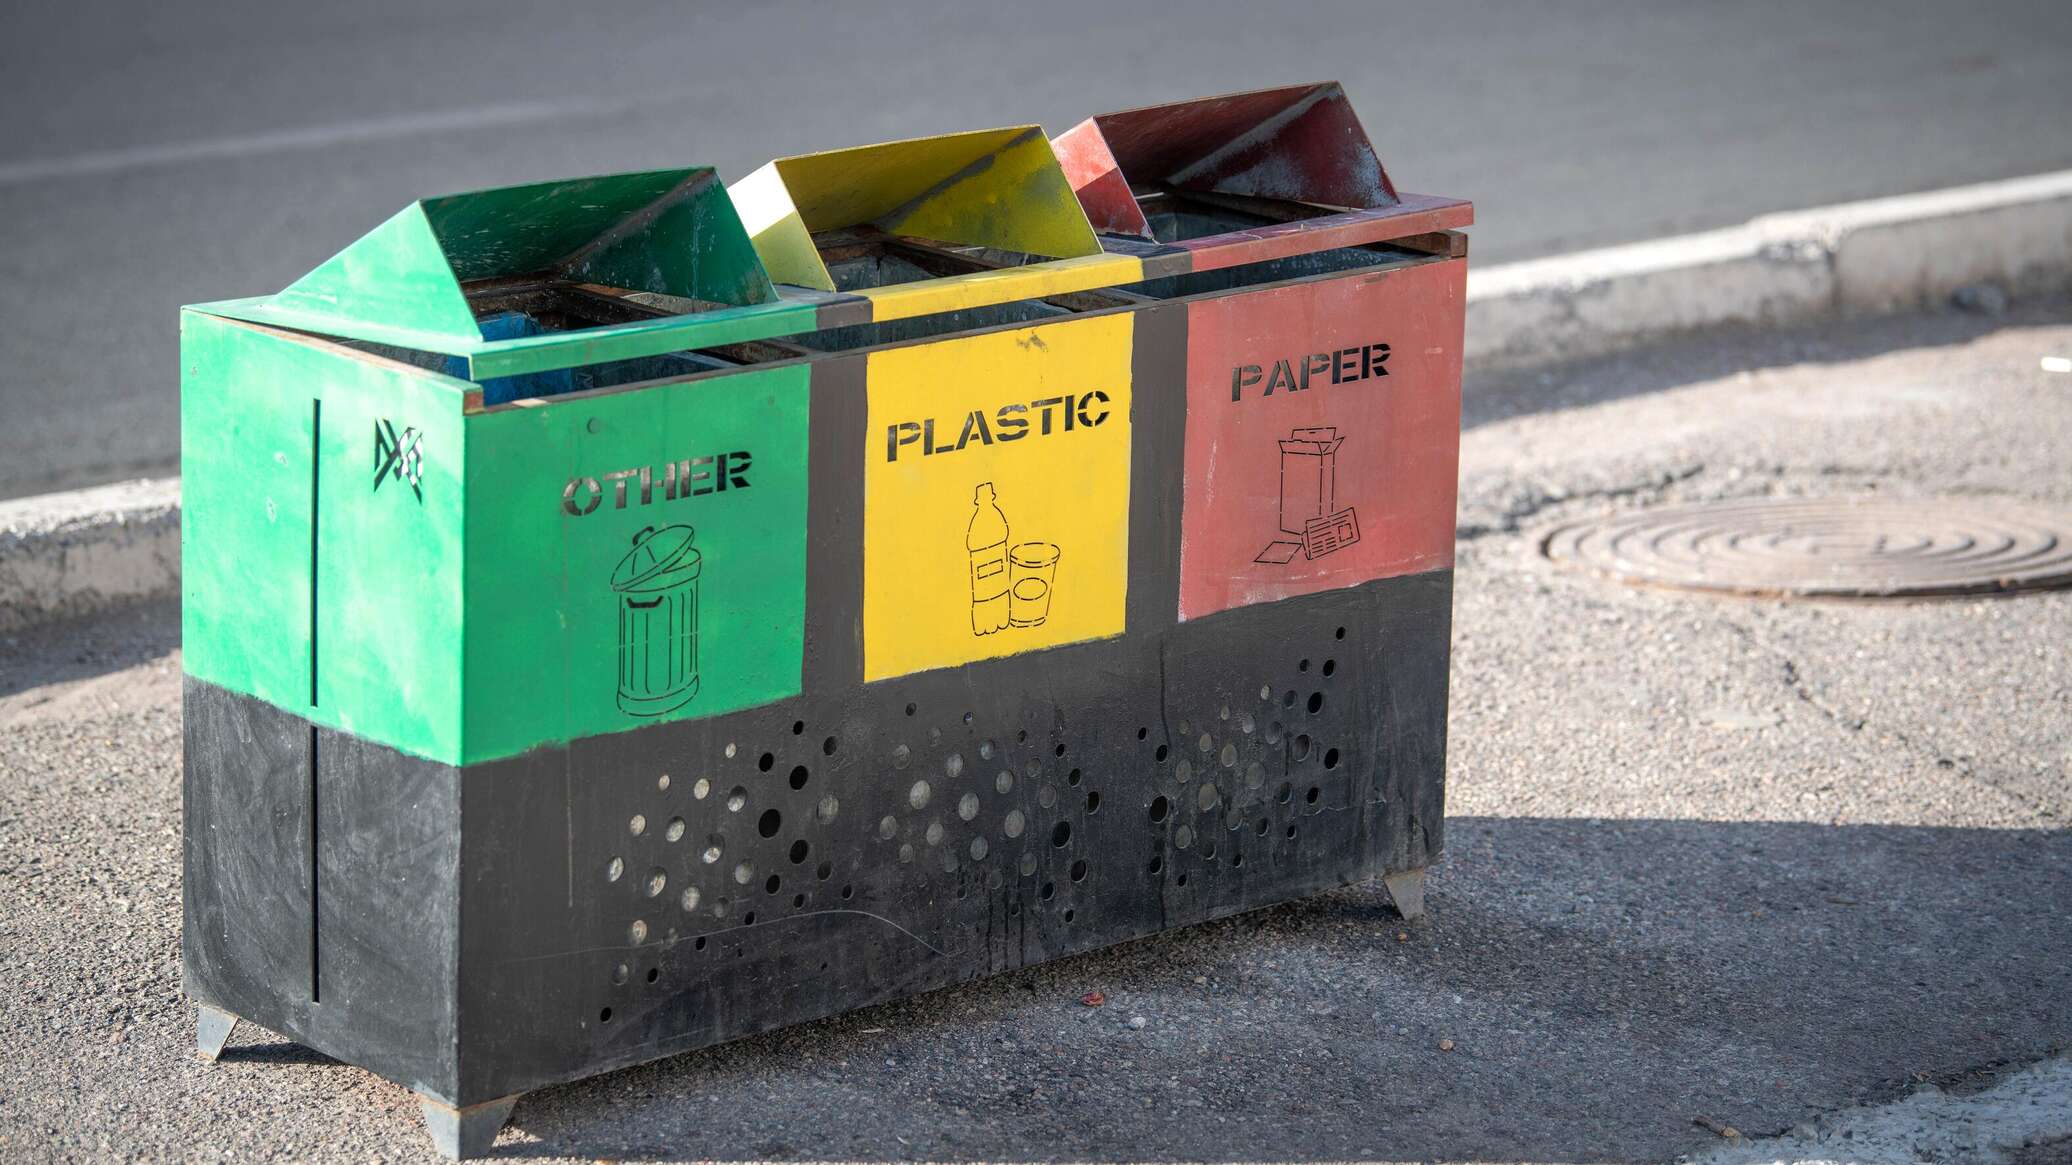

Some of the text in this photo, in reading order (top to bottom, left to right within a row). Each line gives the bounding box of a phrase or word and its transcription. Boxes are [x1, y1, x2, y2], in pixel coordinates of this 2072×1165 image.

[1231, 343, 1391, 402] PAPER
[887, 391, 1110, 462] PLASTIC
[563, 451, 752, 516] OTHER
